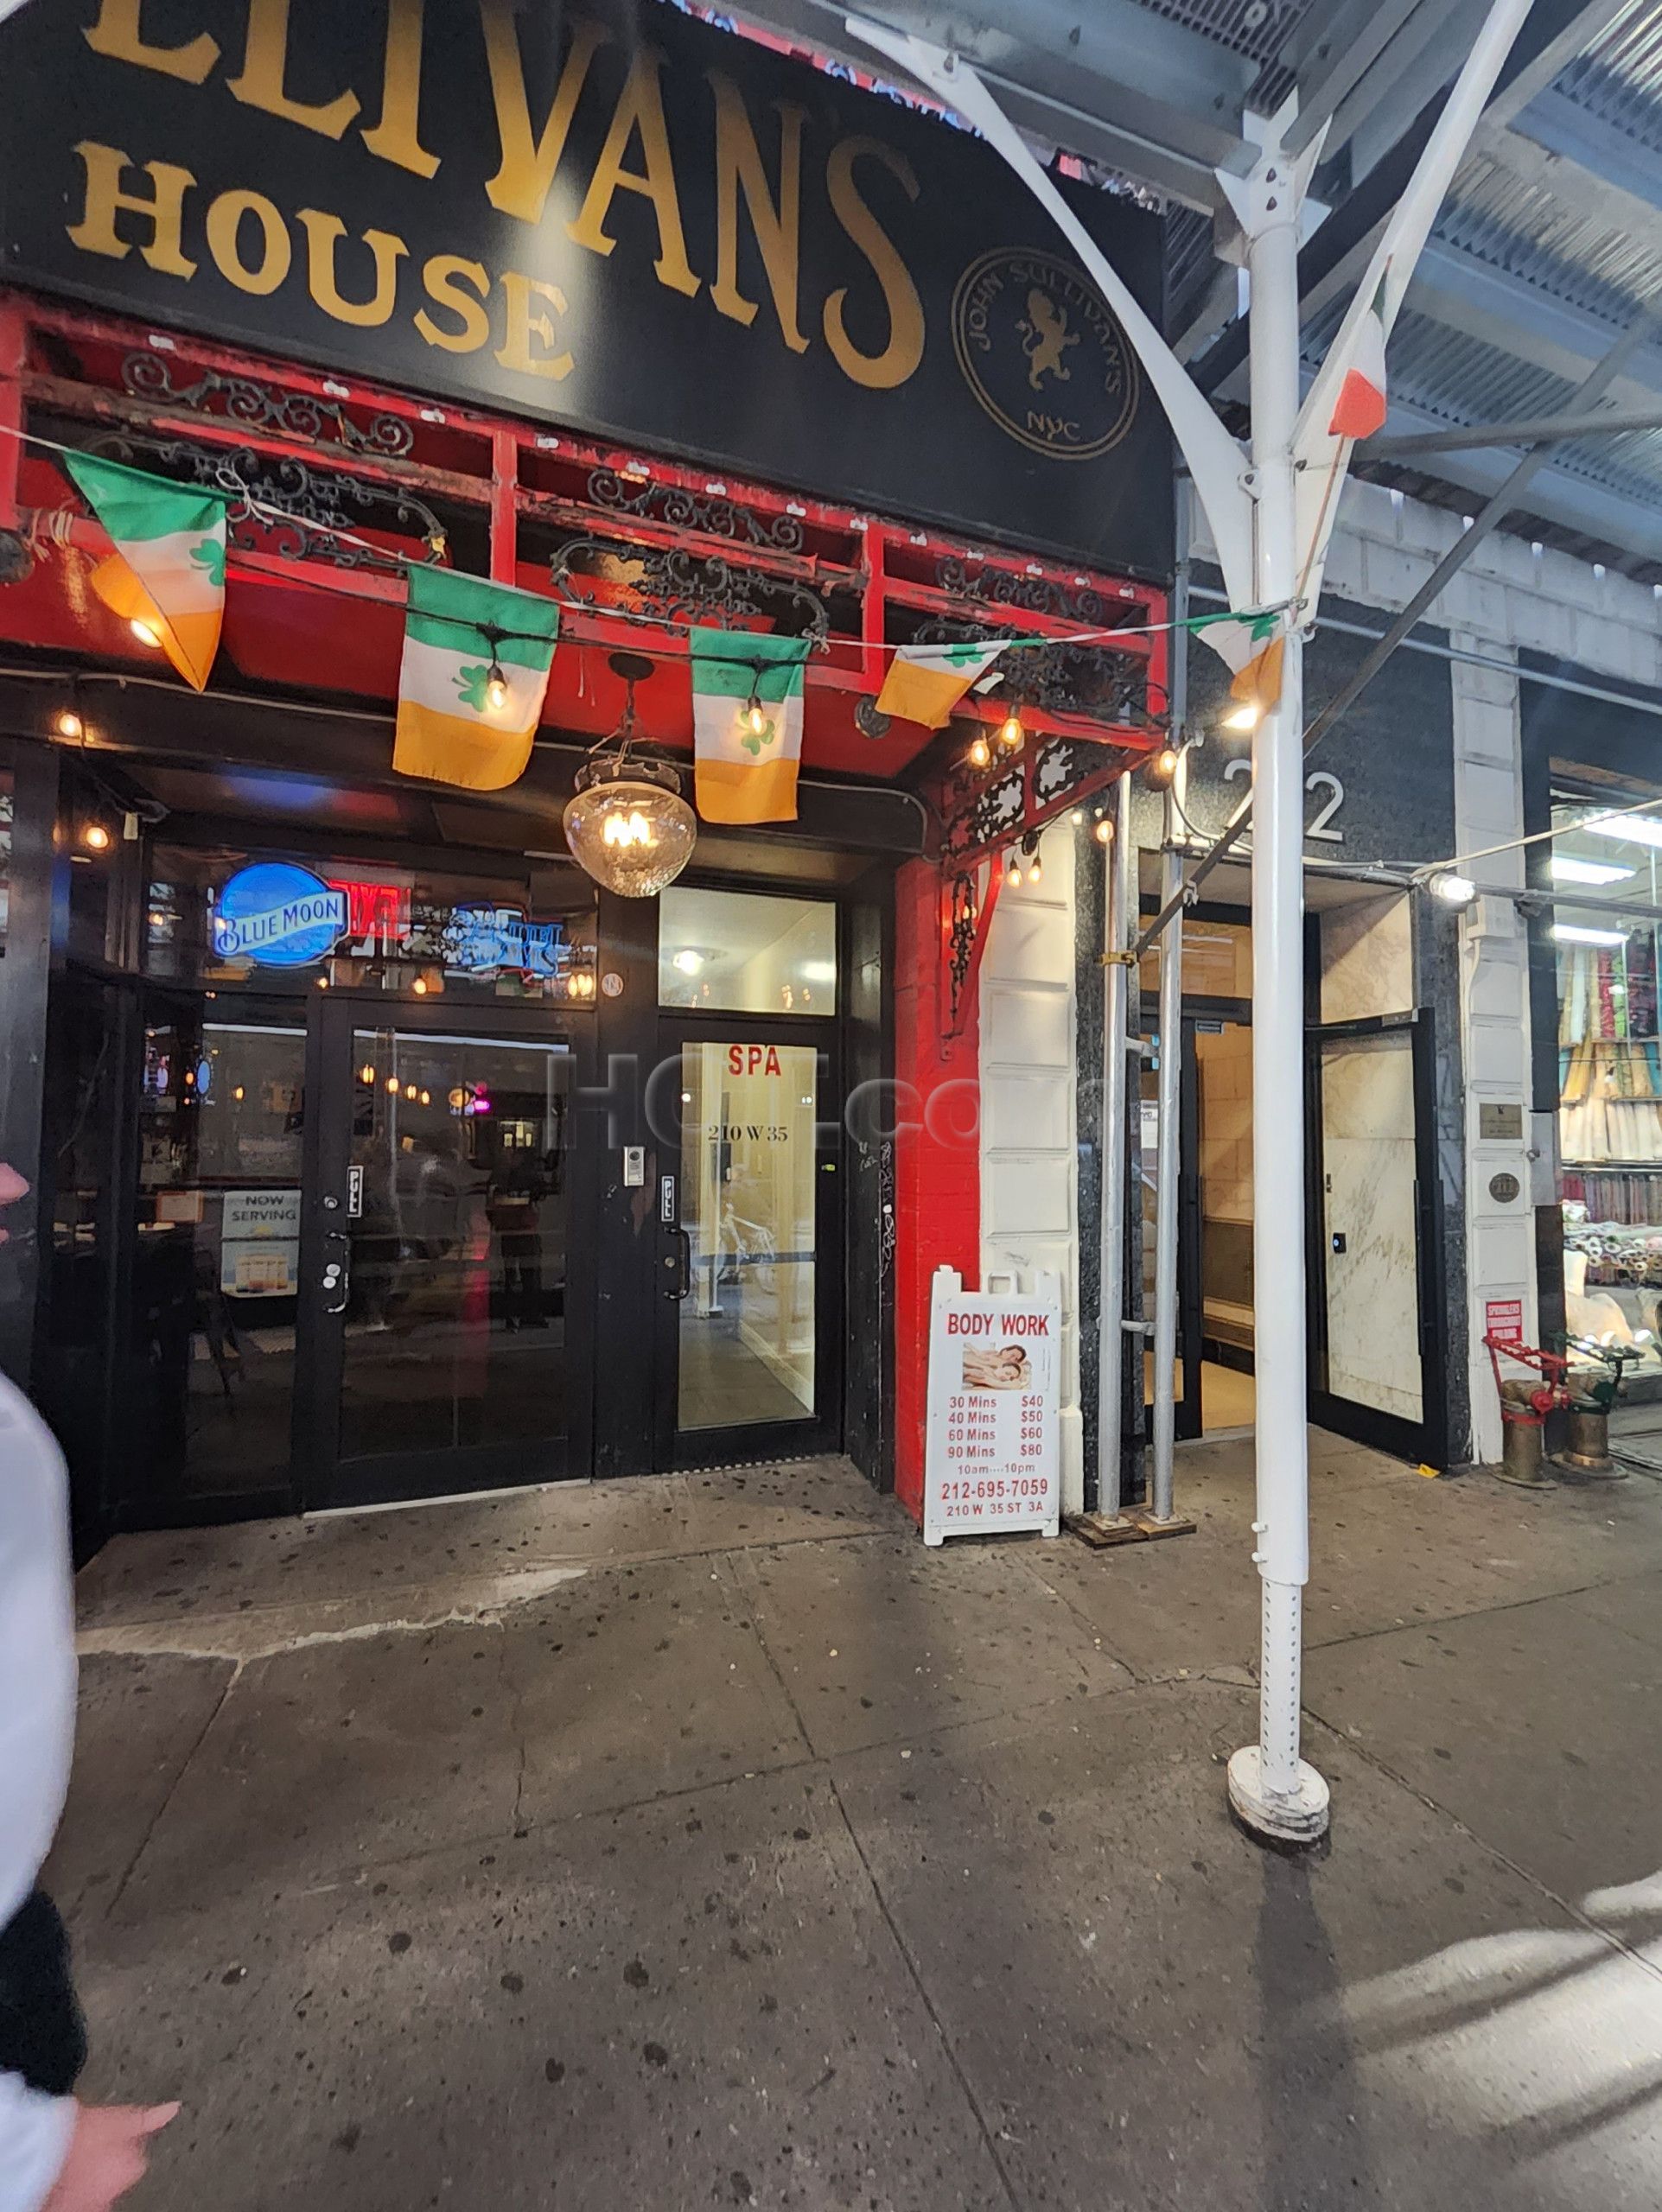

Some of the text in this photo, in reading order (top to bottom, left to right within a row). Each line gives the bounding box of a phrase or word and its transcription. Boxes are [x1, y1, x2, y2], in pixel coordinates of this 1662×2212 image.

[66, 140, 575, 382] HOUSE
[969, 272, 1004, 352] JOHN
[1027, 410, 1081, 442] NYC
[1224, 759, 1344, 842] 22
[217, 896, 340, 953] BLUE MOON
[728, 1045, 782, 1077] SPA
[708, 1125, 788, 1141] 210 W 35
[245, 1195, 285, 1205] NOW
[349, 1171, 360, 1213] PULL
[232, 1210, 296, 1222] SERVING
[947, 1313, 1050, 1337] BODY WORK
[949, 1395, 1044, 1408] 30 Mins $40
[948, 1410, 1043, 1424] 40 Mins $50
[948, 1427, 1043, 1441] 60 Mins $60
[947, 1444, 1042, 1459] 90 Mins $80
[941, 1478, 1048, 1501] 212-695-7059
[946, 1501, 1044, 1517] 210 W 35 ST 3A
